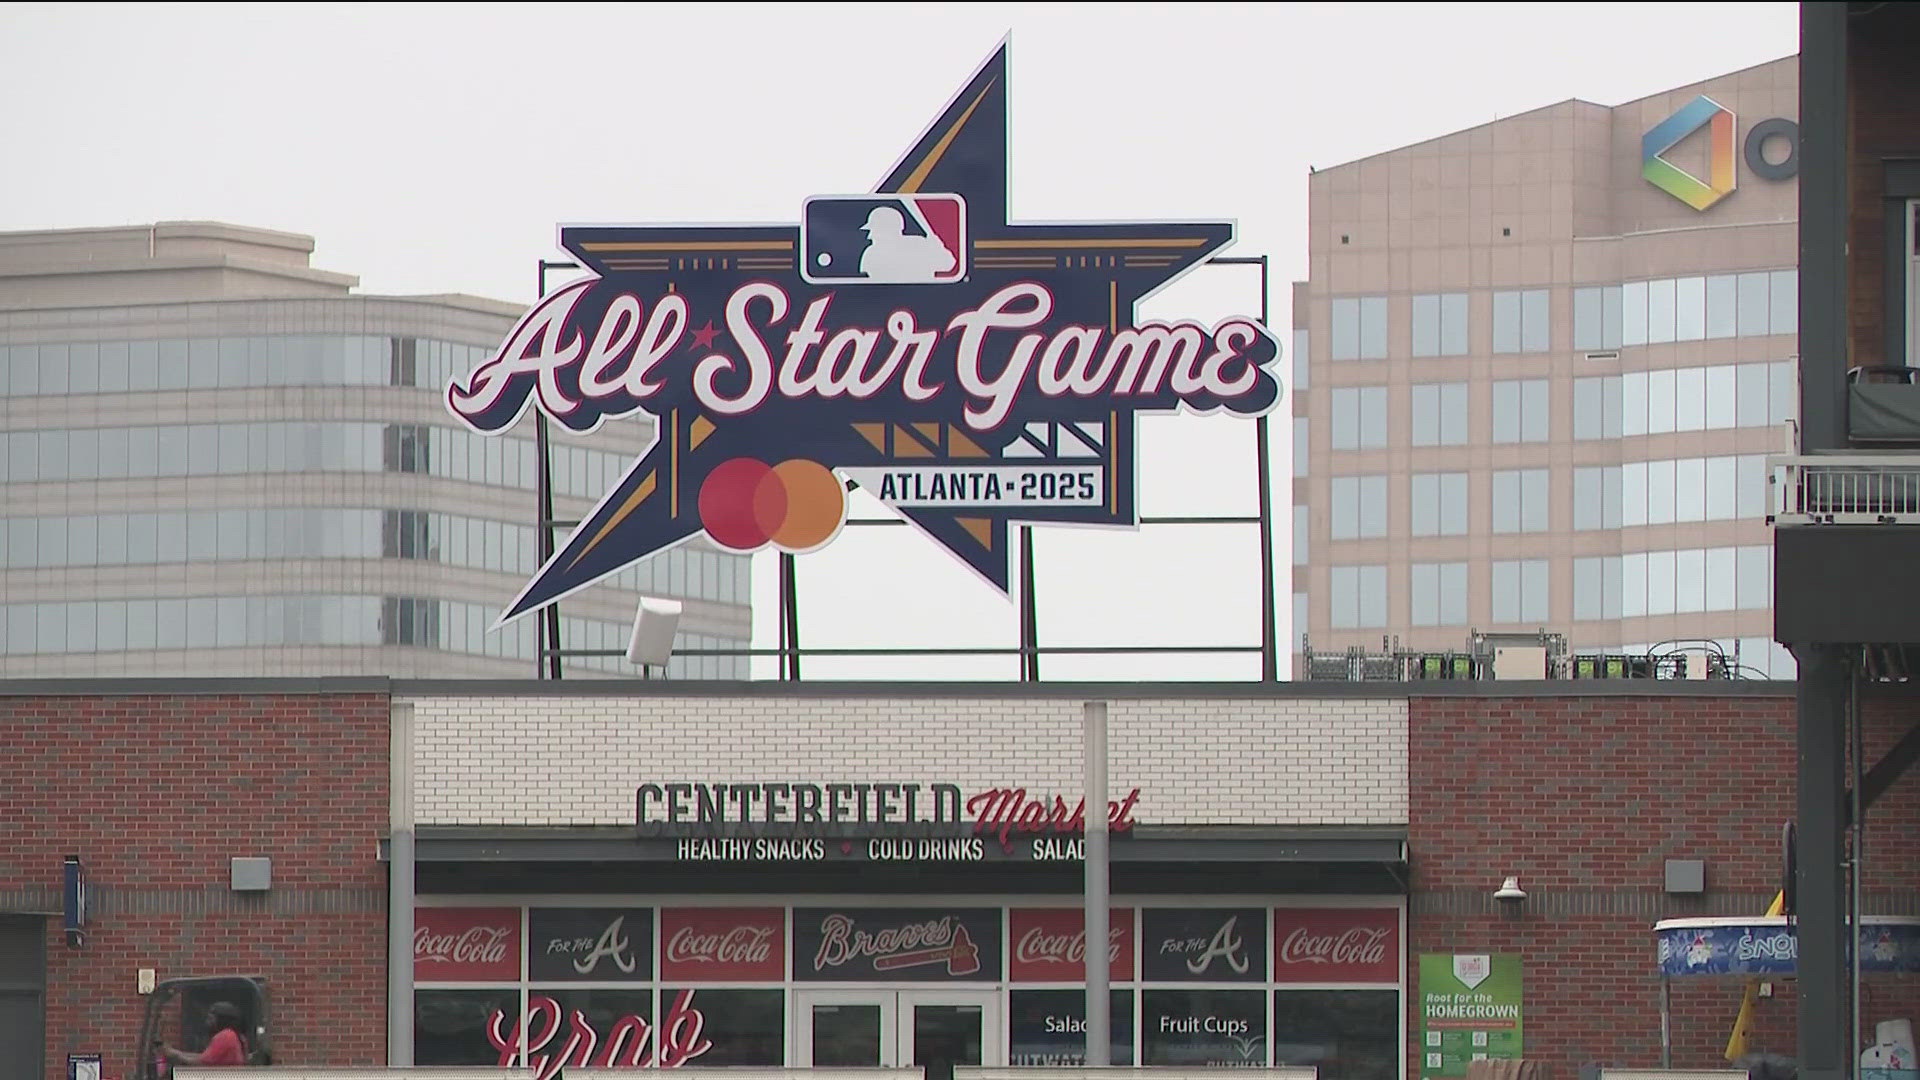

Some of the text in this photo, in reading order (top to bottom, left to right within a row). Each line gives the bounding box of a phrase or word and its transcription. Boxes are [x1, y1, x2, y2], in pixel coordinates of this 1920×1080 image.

[447, 279, 1264, 432] All Star Game
[880, 472, 1094, 500] ATLANTA 2025
[636, 783, 963, 838] CENTERFIELD
[678, 839, 826, 861] HEALTHY SNACKS
[868, 839, 984, 861] COLD DRINKS
[546, 915, 636, 974] FOR THE A
[667, 926, 777, 963] Coca-Cola
[813, 913, 952, 971] Braves
[1016, 926, 1126, 963] Coca-Ca
[1160, 915, 1249, 974] FOR THE A
[1281, 926, 1391, 964] Coca-Cola
[1739, 933, 1798, 960] SNO
[1426, 993, 1493, 1004] Root for the
[1426, 1004, 1519, 1018] HOMEGROWN
[1160, 1016, 1248, 1038] Fruit Cups
